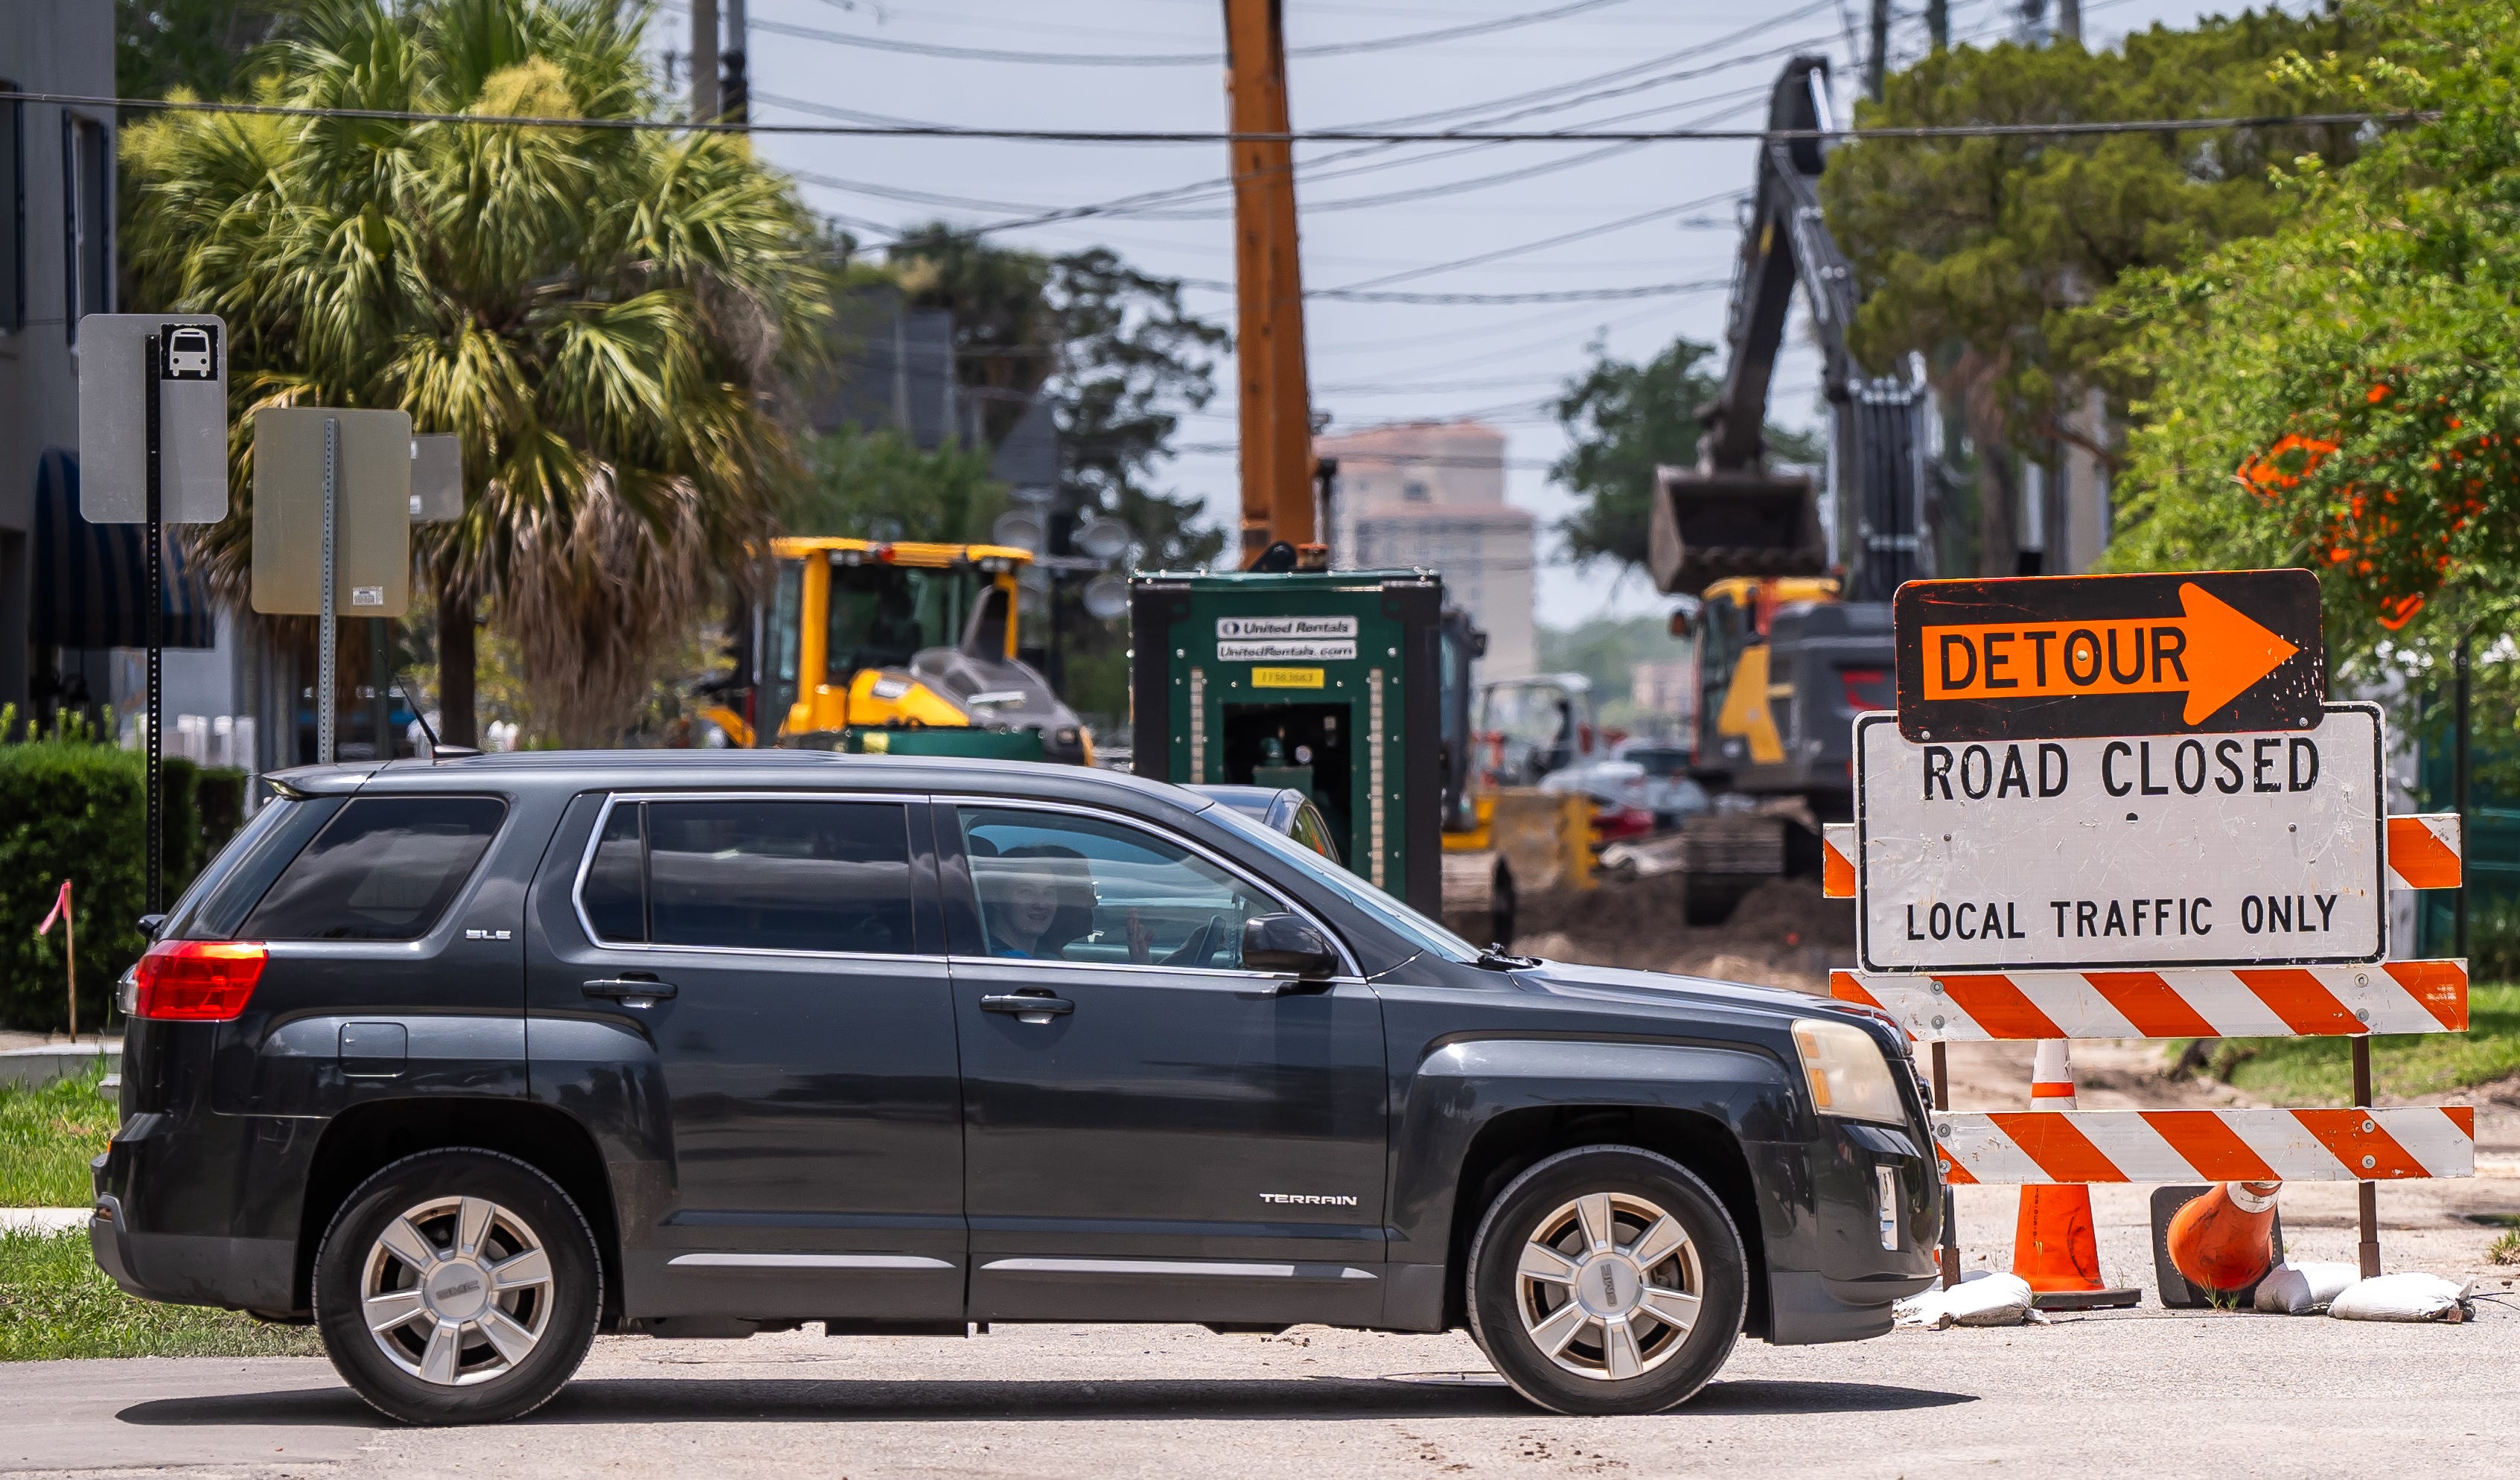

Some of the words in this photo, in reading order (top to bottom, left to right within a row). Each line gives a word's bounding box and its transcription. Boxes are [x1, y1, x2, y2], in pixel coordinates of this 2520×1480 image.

[1243, 621, 1292, 634] United
[1296, 620, 1349, 633] Rentals
[1220, 645, 1353, 657] UnitedRentals.com
[1939, 626, 2189, 691] DETOUR
[1923, 742, 2068, 801] ROAD
[2102, 737, 2320, 797] CLOSED
[1907, 902, 2026, 941] LOCAL
[2050, 897, 2213, 938] TRAFFIC
[2241, 894, 2338, 934] ONLY
[465, 929, 511, 940] SLE
[1258, 1193, 1358, 1206] TERRAIN
[435, 1280, 481, 1301] GMC
[1600, 1263, 1618, 1307] GMC
